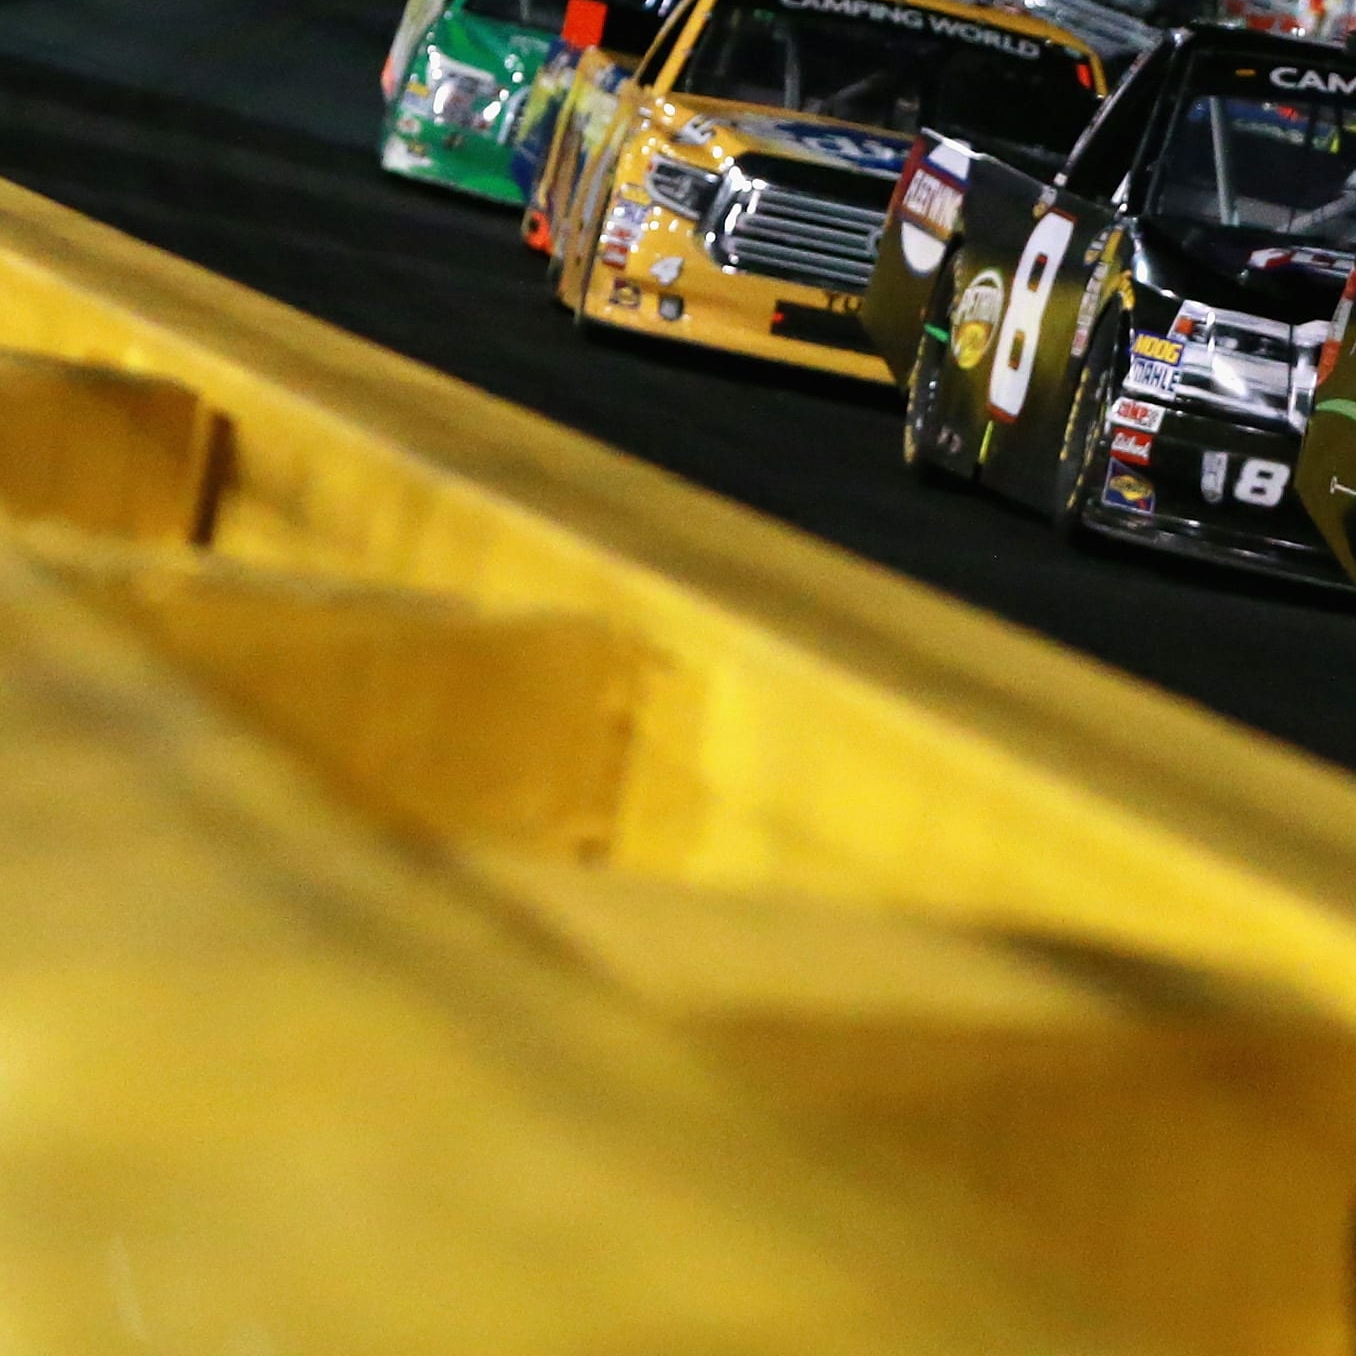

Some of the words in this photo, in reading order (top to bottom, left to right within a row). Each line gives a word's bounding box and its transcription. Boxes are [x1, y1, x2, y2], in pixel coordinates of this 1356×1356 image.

[928, 14, 1040, 59] WORLD
[989, 209, 1075, 423] 8
[1131, 334, 1184, 365] MOOG
[1233, 458, 1291, 507] 8
